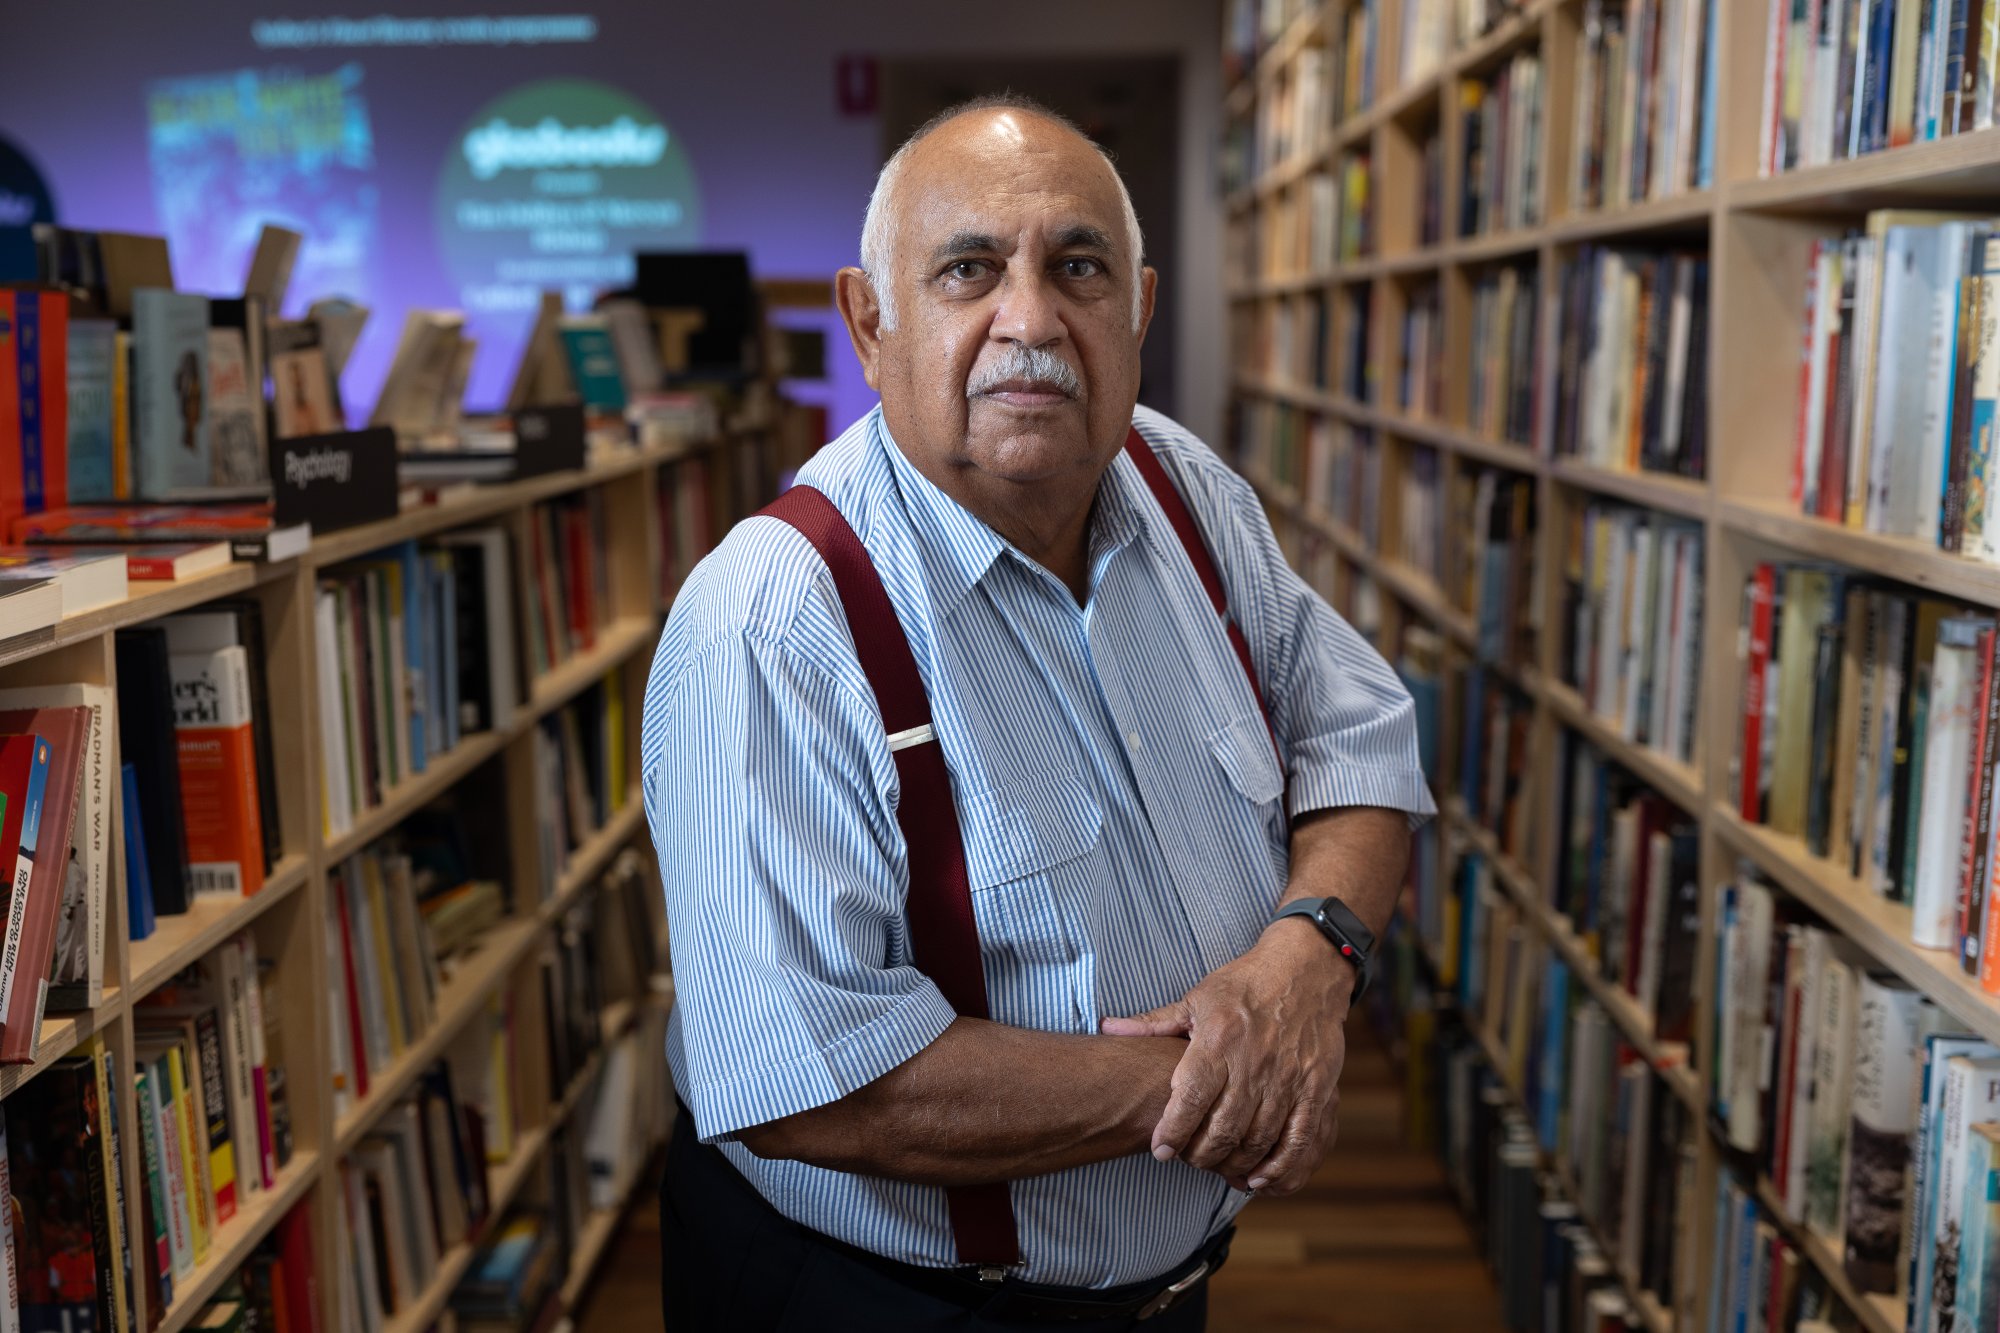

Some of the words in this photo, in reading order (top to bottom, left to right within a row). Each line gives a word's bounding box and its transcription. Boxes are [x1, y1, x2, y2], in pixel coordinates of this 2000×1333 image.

[82, 726, 90, 746] THE
[93, 704, 102, 805] BRADMAN'S
[75, 753, 86, 802] BICYCLE
[67, 809, 76, 848] BOOK
[93, 812, 102, 851] WAR
[20, 871, 28, 900] ONE
[12, 888, 21, 926] LEGEND
[13, 901, 24, 942] GOOD
[9, 928, 16, 943] OF
[5, 944, 13, 969] BURT
[8, 943, 18, 972] RUN
[0, 971, 8, 1012] MUNRO
[0, 1159, 11, 1227] HAROLD
[4, 1233, 18, 1310] LARWOOD
